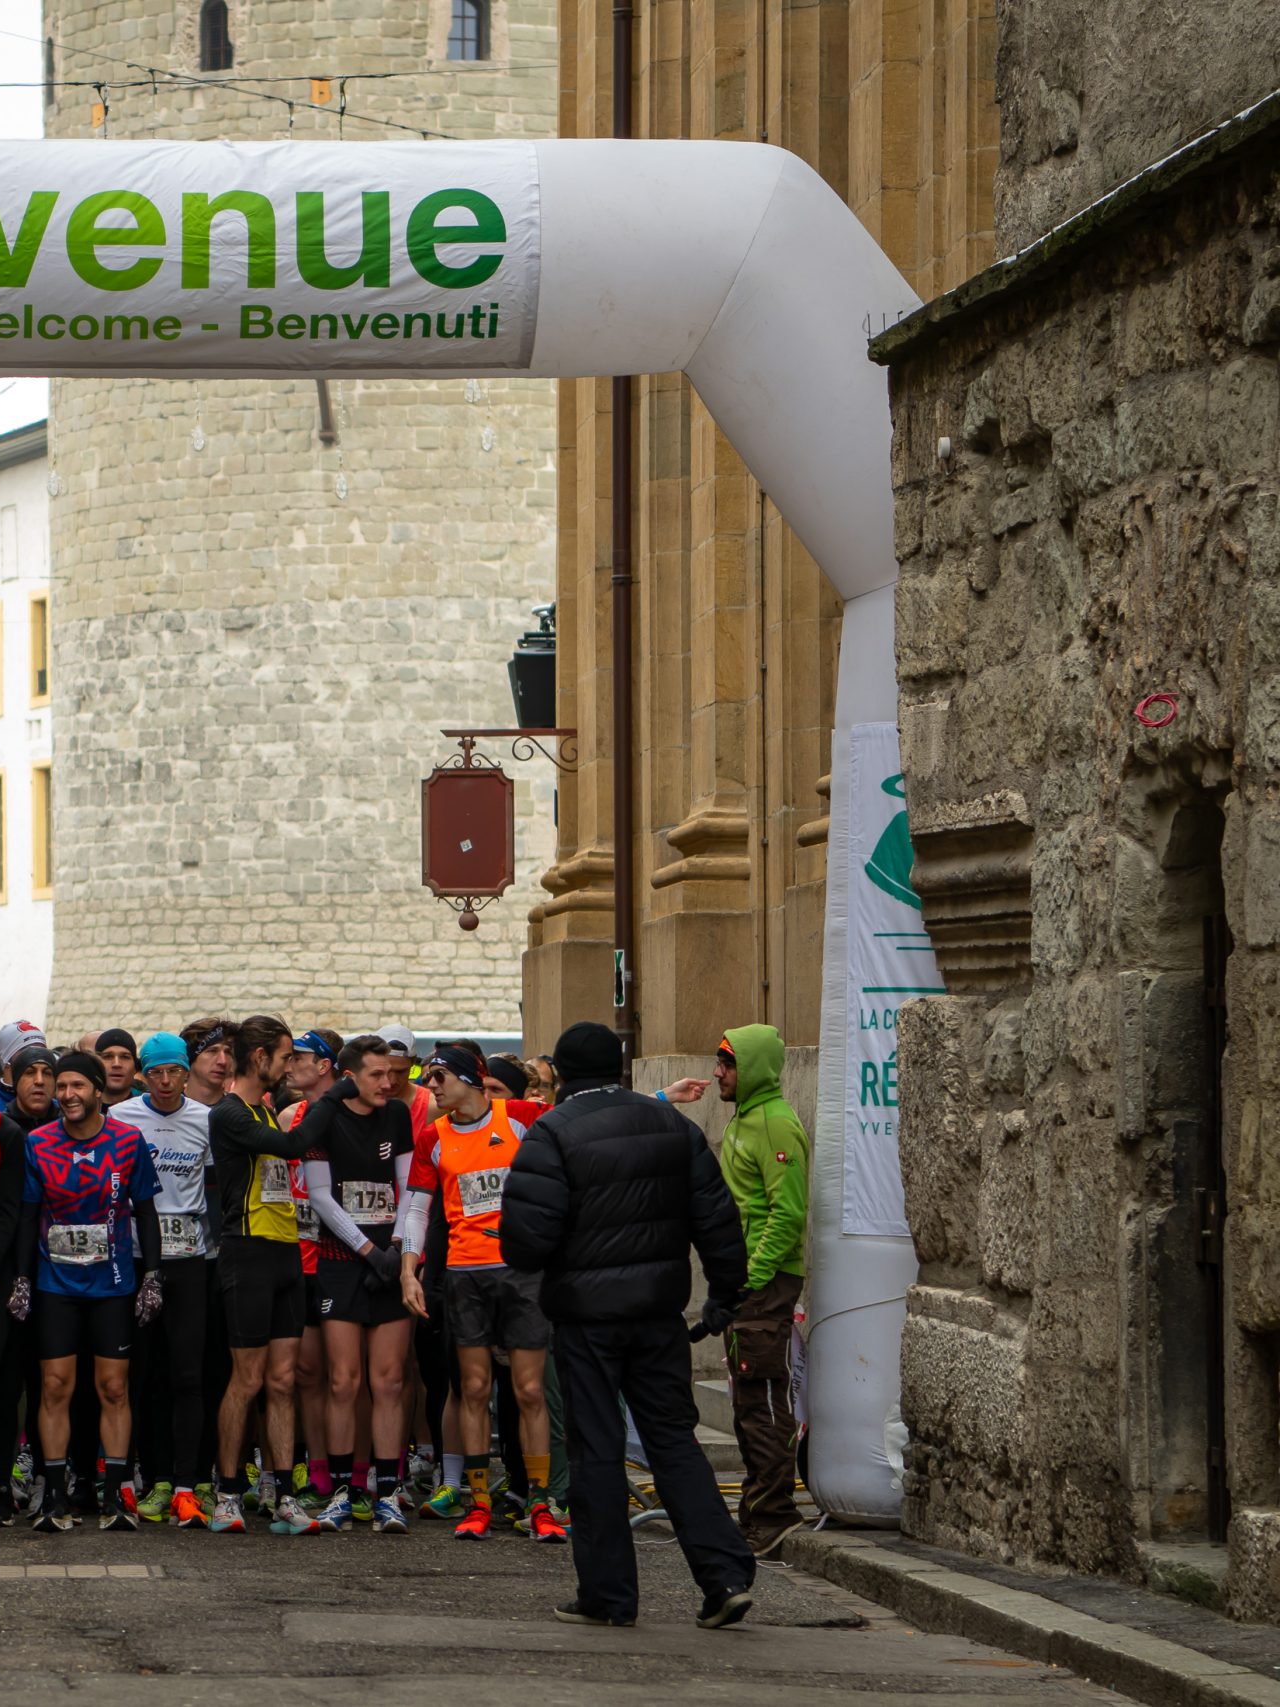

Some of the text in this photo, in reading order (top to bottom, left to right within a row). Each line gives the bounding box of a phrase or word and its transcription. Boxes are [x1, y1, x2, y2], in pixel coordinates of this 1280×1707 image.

[201, 323, 219, 331] -
[240, 302, 499, 340] Benvenuti
[860, 1009, 878, 1030] LA
[861, 1122, 899, 1136] YVE
[477, 1174, 500, 1191] 10
[355, 1190, 387, 1209] 175
[66, 1230, 88, 1246] 13
